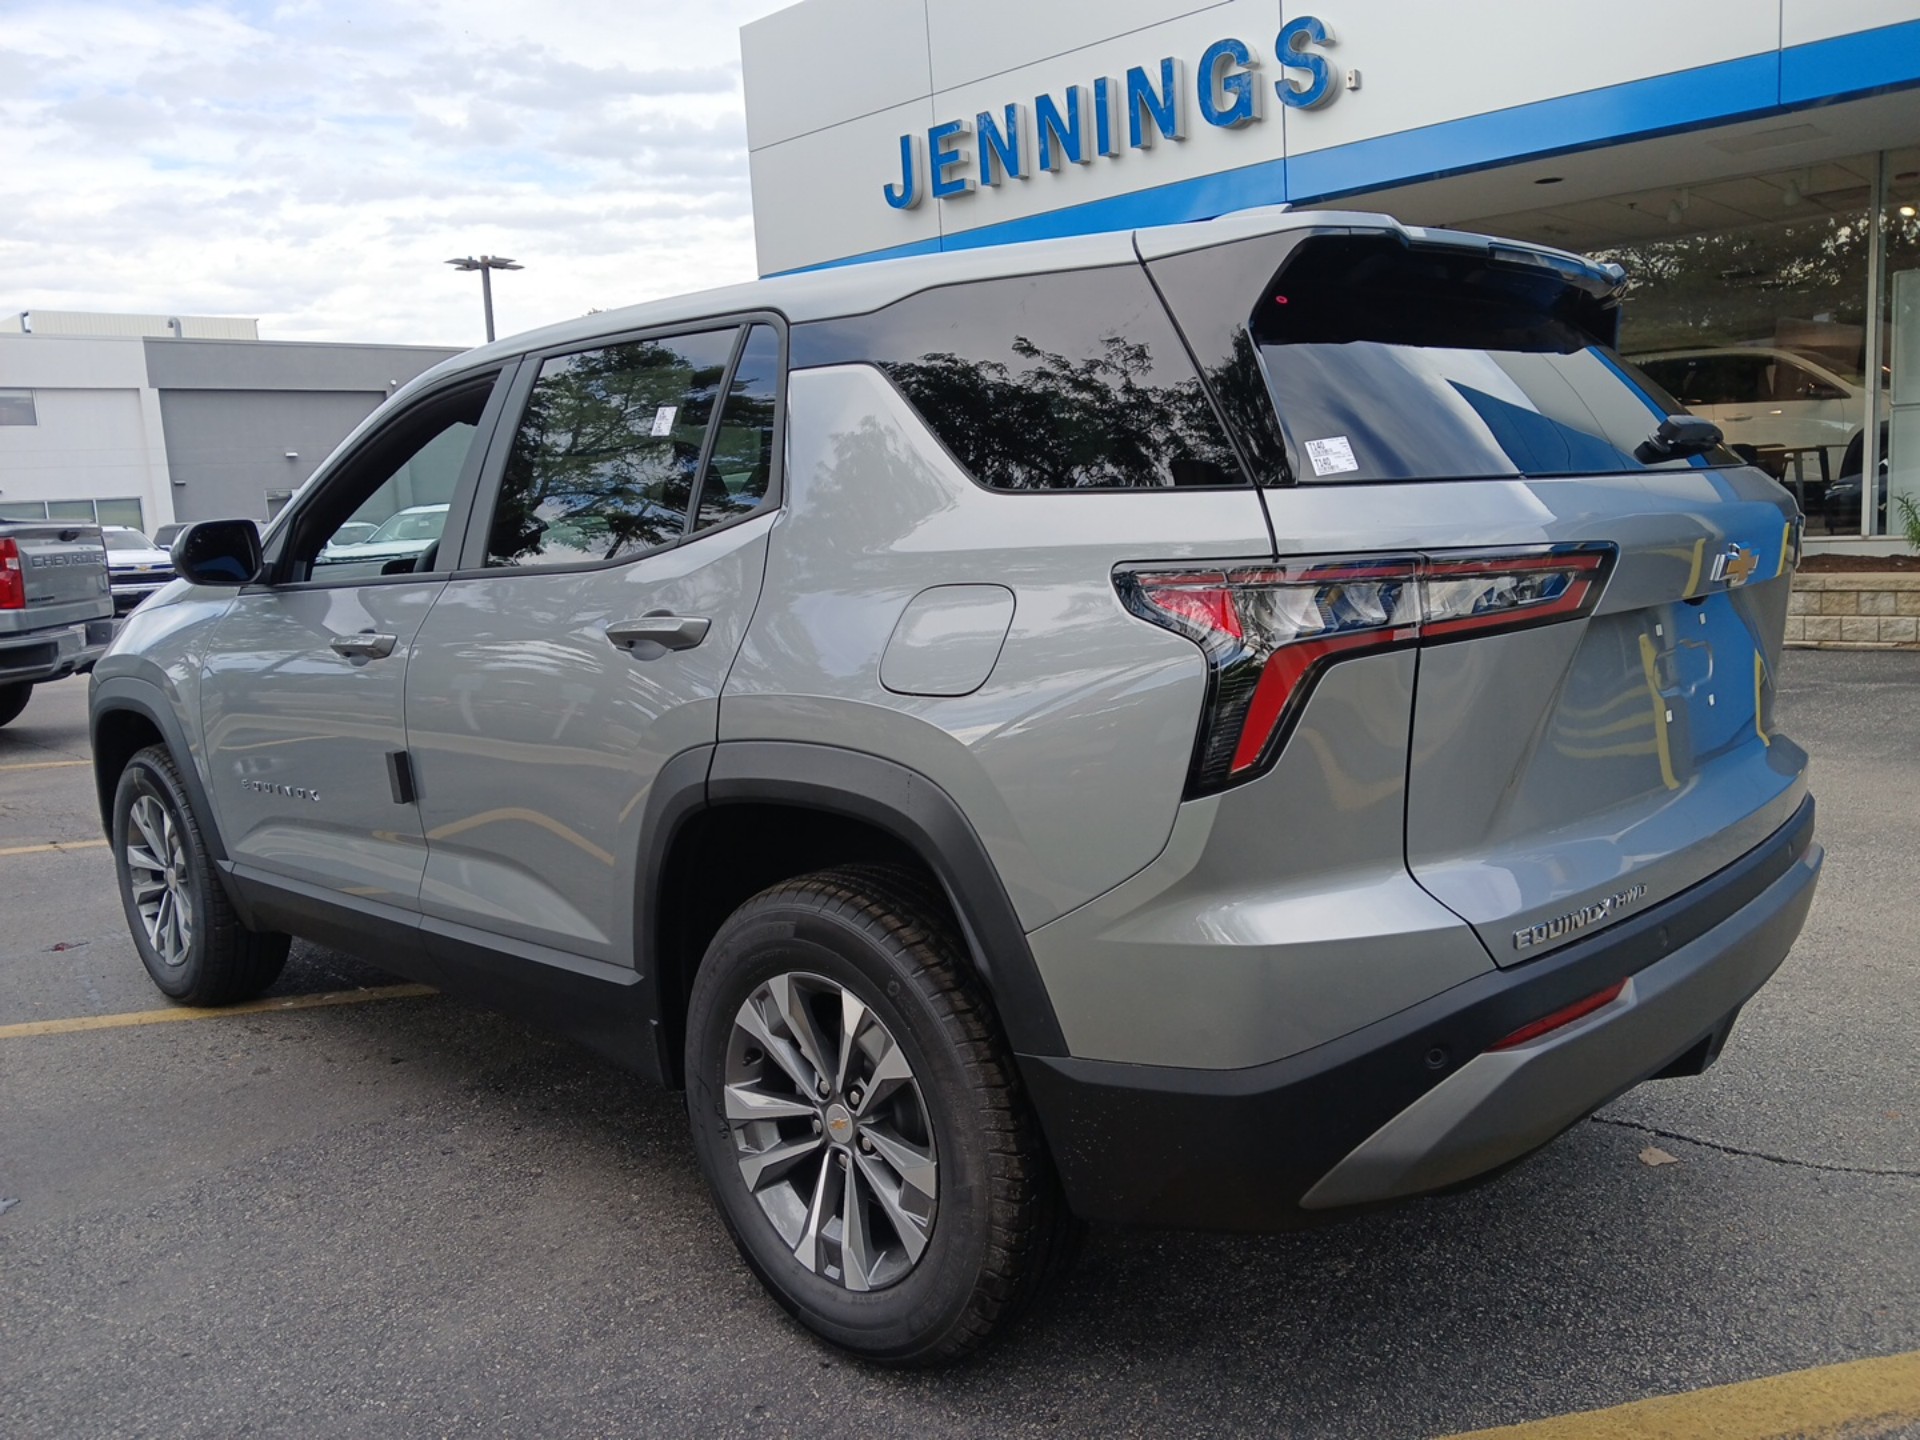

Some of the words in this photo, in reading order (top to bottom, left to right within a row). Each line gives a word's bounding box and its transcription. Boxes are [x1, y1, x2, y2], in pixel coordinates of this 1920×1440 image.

[883, 15, 1337, 210] JENNINGS
[240, 778, 321, 802] EQUINOX
[1513, 898, 1612, 950] EQUINOX
[1614, 883, 1648, 909] AWD
